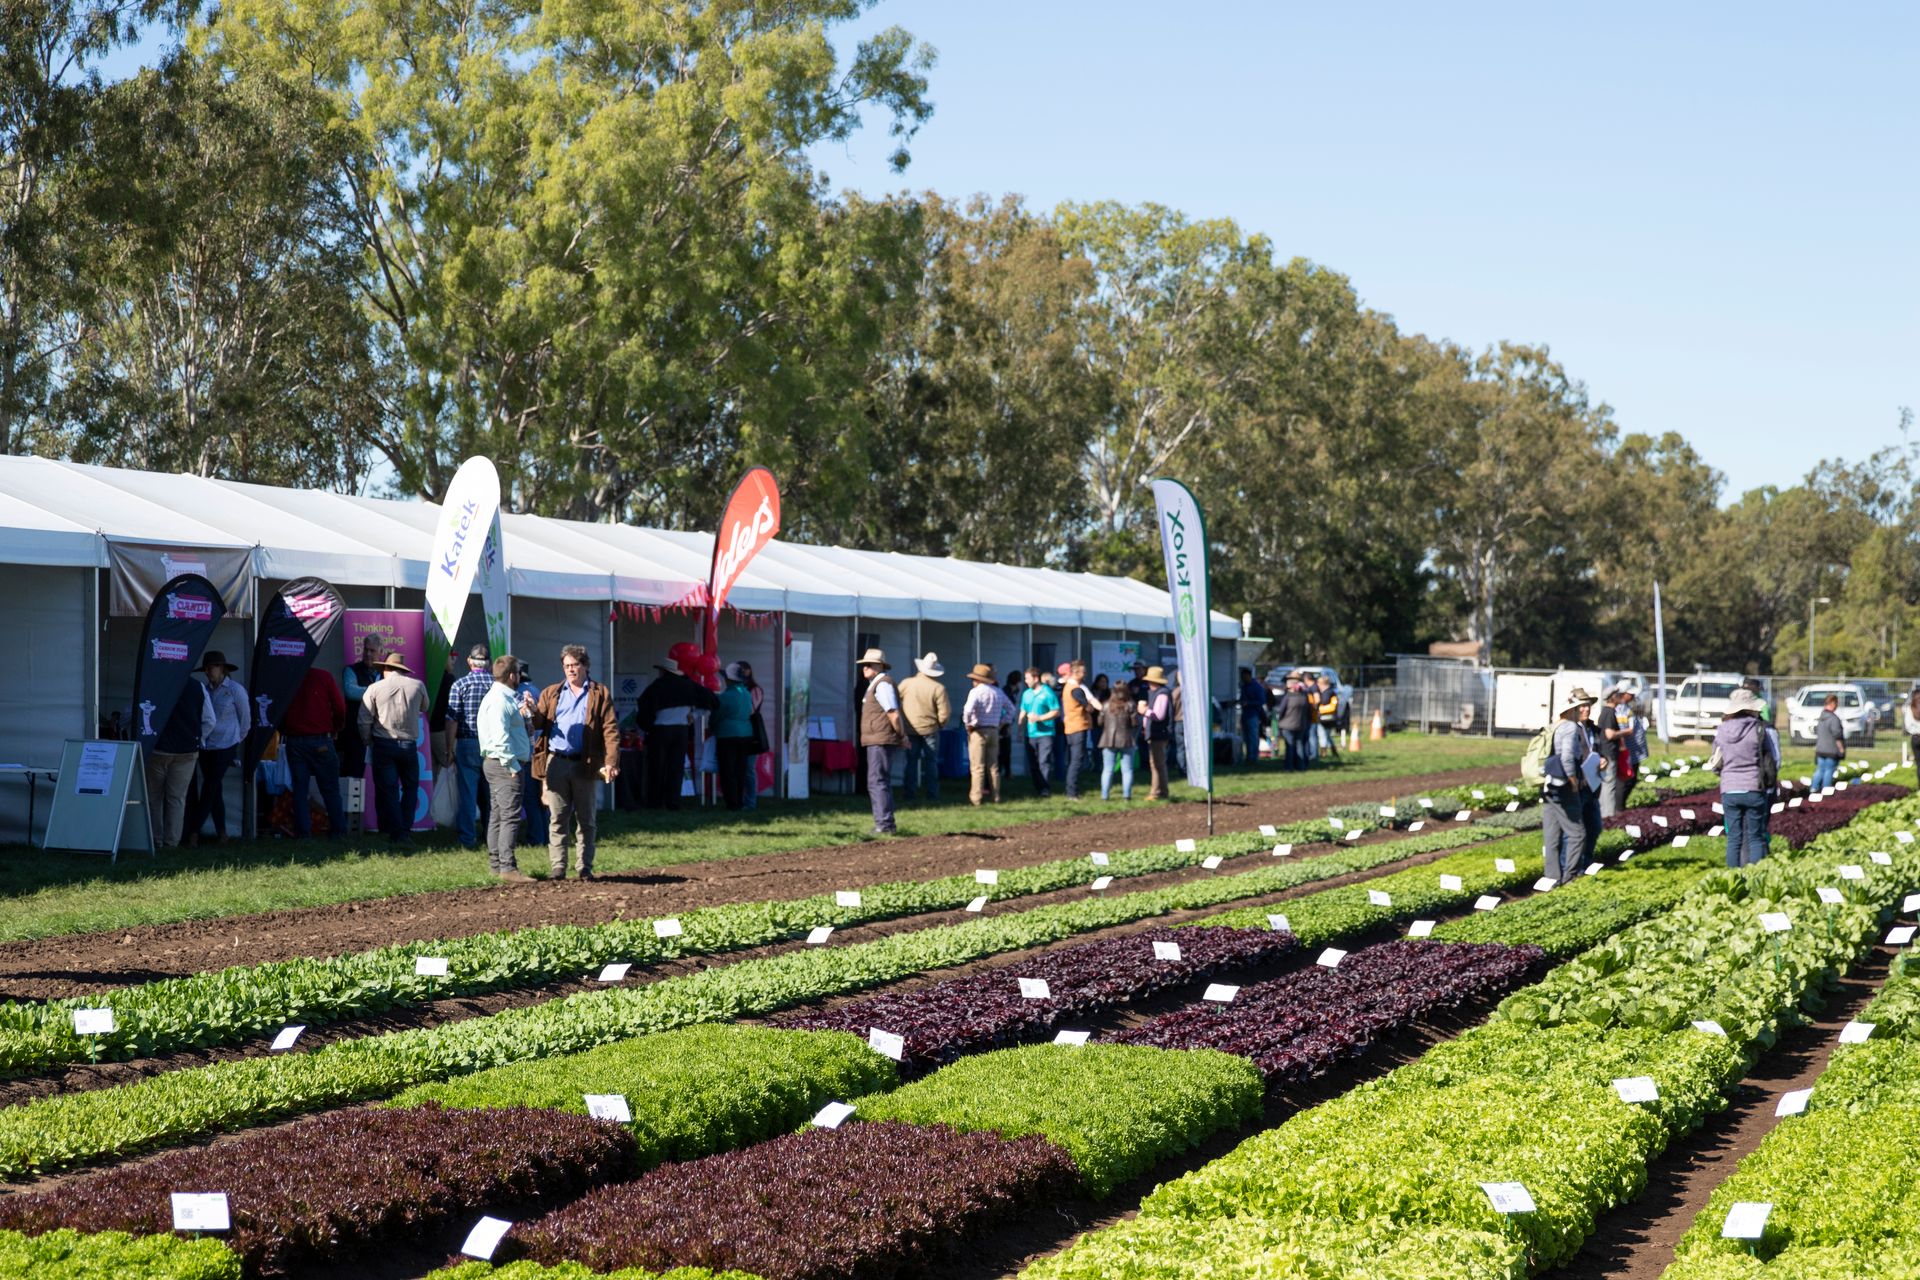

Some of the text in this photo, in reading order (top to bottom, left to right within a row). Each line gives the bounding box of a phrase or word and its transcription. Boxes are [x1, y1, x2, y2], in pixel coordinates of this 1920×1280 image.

[441, 499, 476, 577] Katek
[712, 495, 774, 612] lders
[177, 600, 210, 613] CANDY
[353, 622, 394, 634] Thinking
